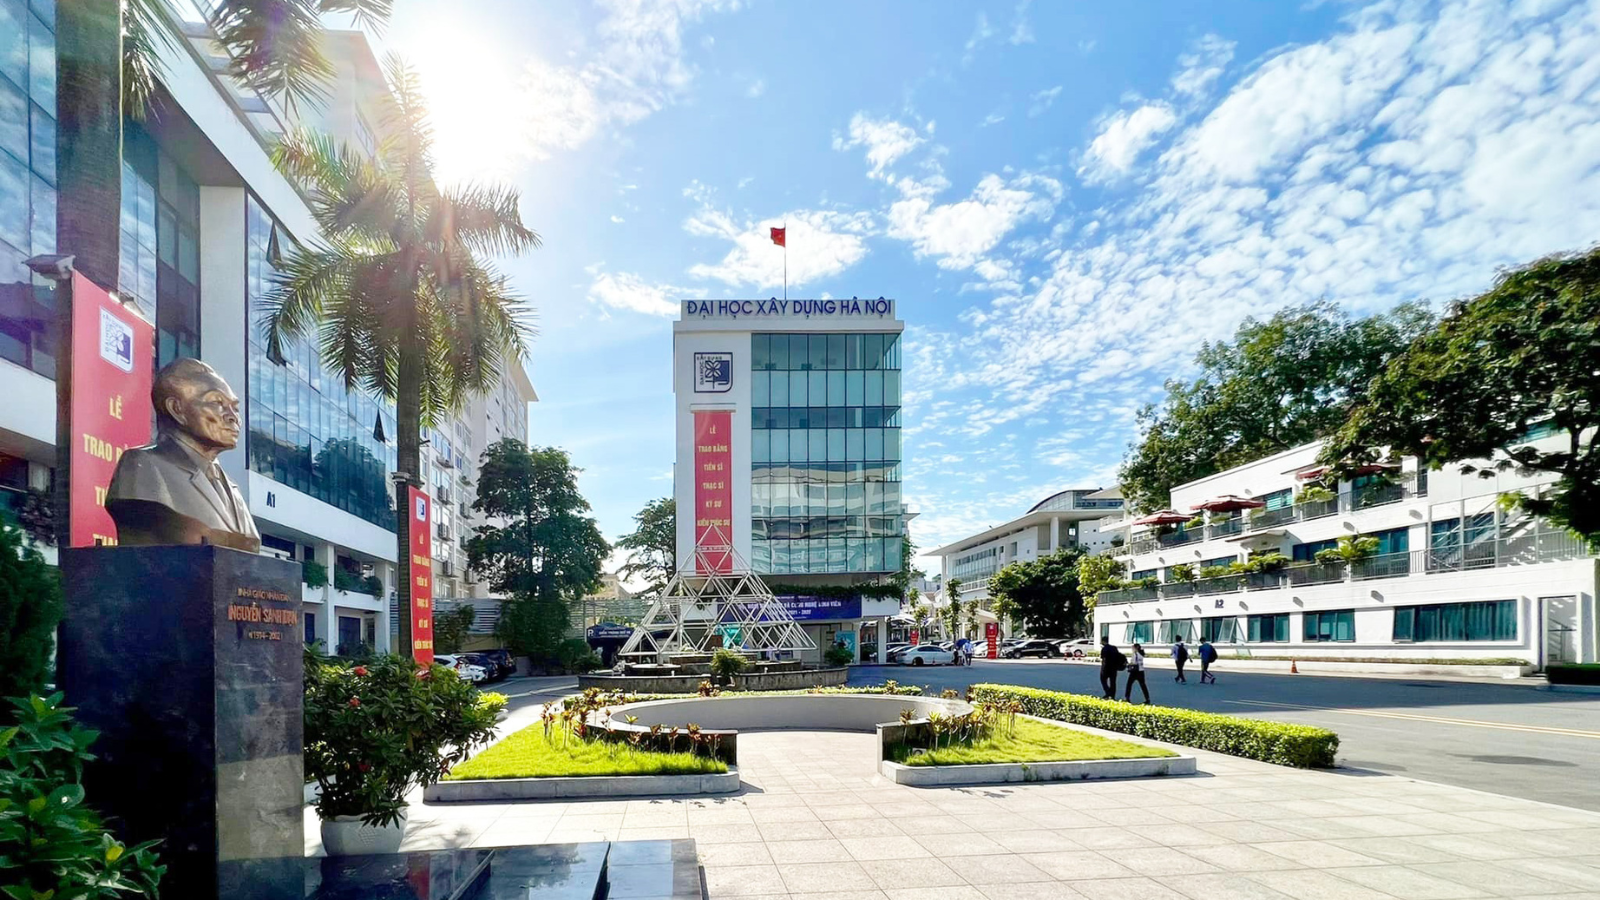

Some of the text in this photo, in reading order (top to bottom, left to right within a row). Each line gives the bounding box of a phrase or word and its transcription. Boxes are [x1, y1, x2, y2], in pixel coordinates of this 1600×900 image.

[687, 296, 891, 319] ĐẠI HỌC XÂY DỰNG HÀ NỘI
[109, 394, 122, 420] LỄ
[709, 424, 717, 434] LỄ
[83, 433, 113, 462] TRAO
[266, 491, 276, 509] A1
[1215, 599, 1225, 608] A2
